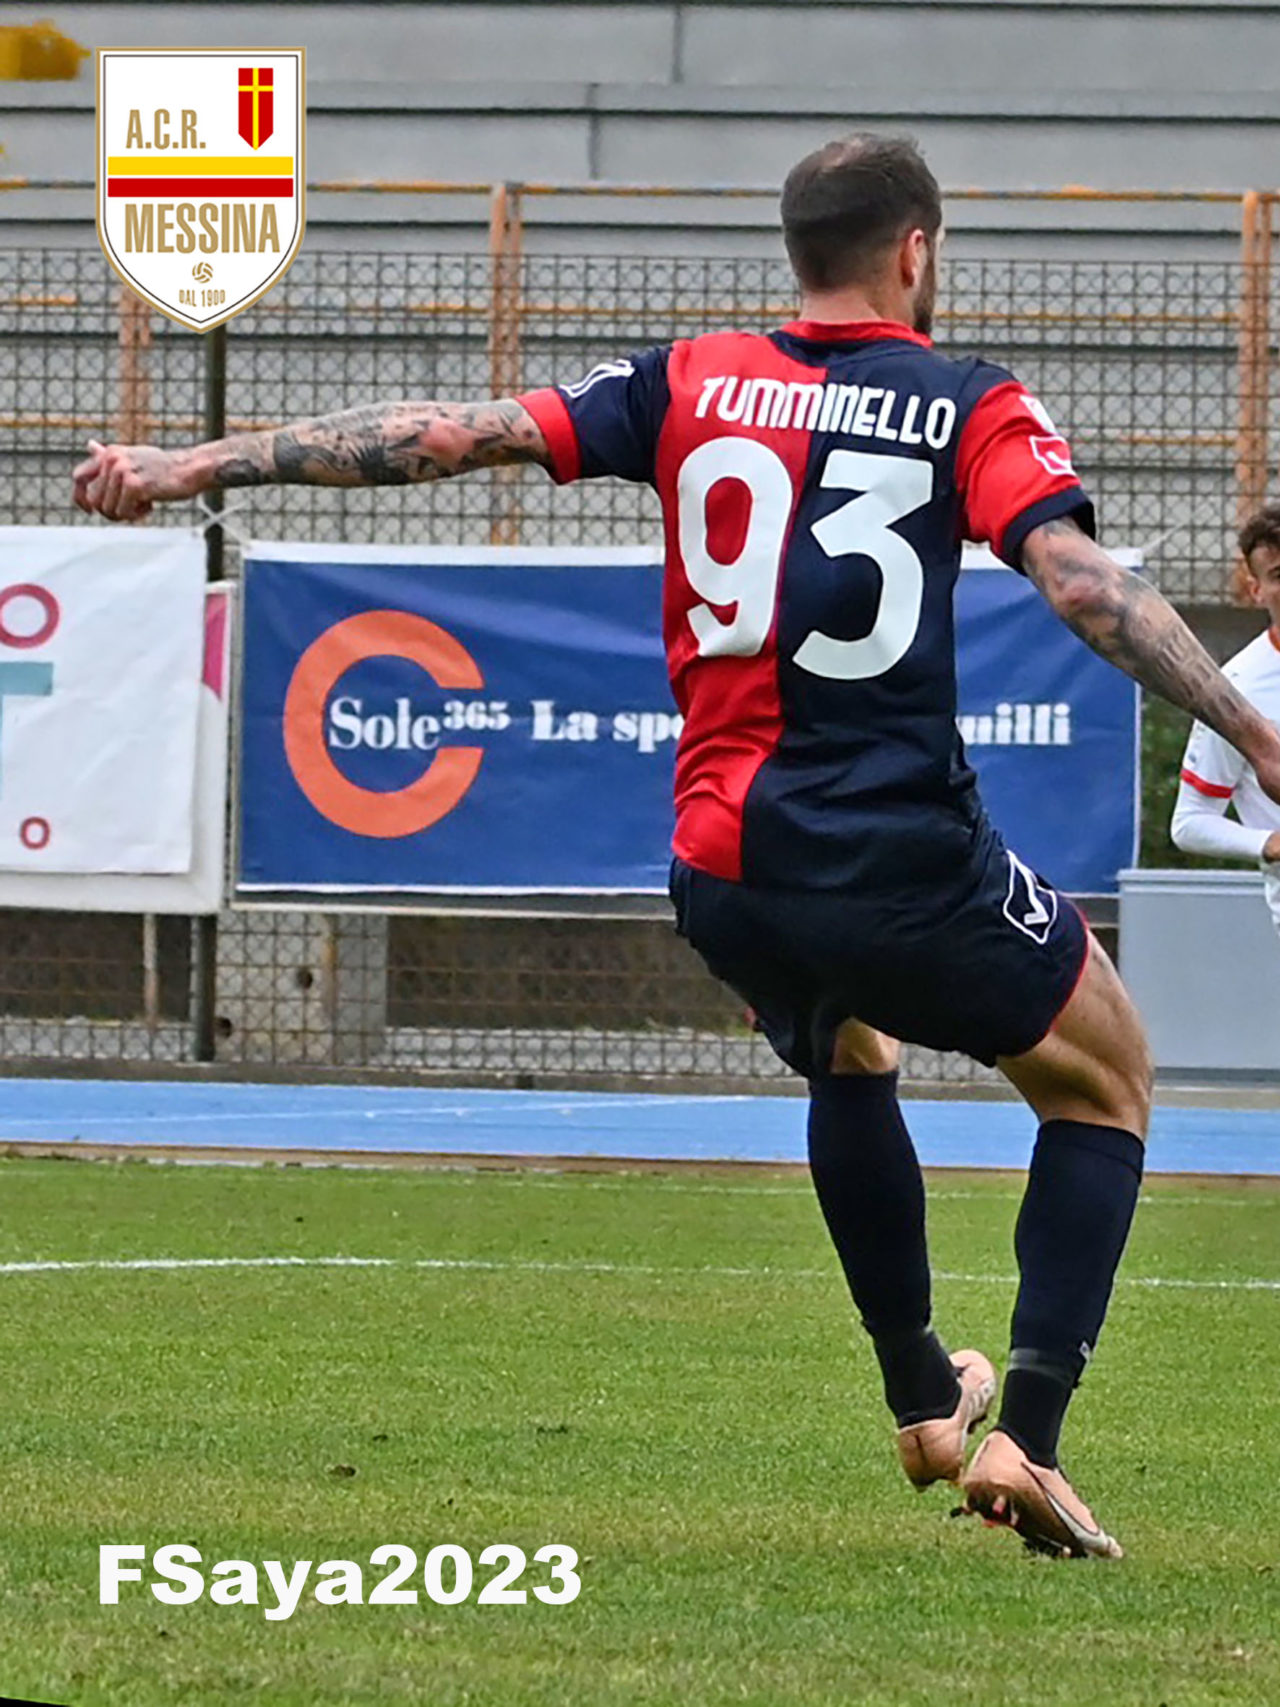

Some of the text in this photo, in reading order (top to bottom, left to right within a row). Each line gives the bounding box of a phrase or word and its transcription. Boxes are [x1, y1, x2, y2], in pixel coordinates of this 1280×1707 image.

[695, 376, 956, 449] TUMMINELLO
[677, 436, 934, 680] 93
[531, 700, 598, 741] La
[956, 702, 1072, 745] uilli
